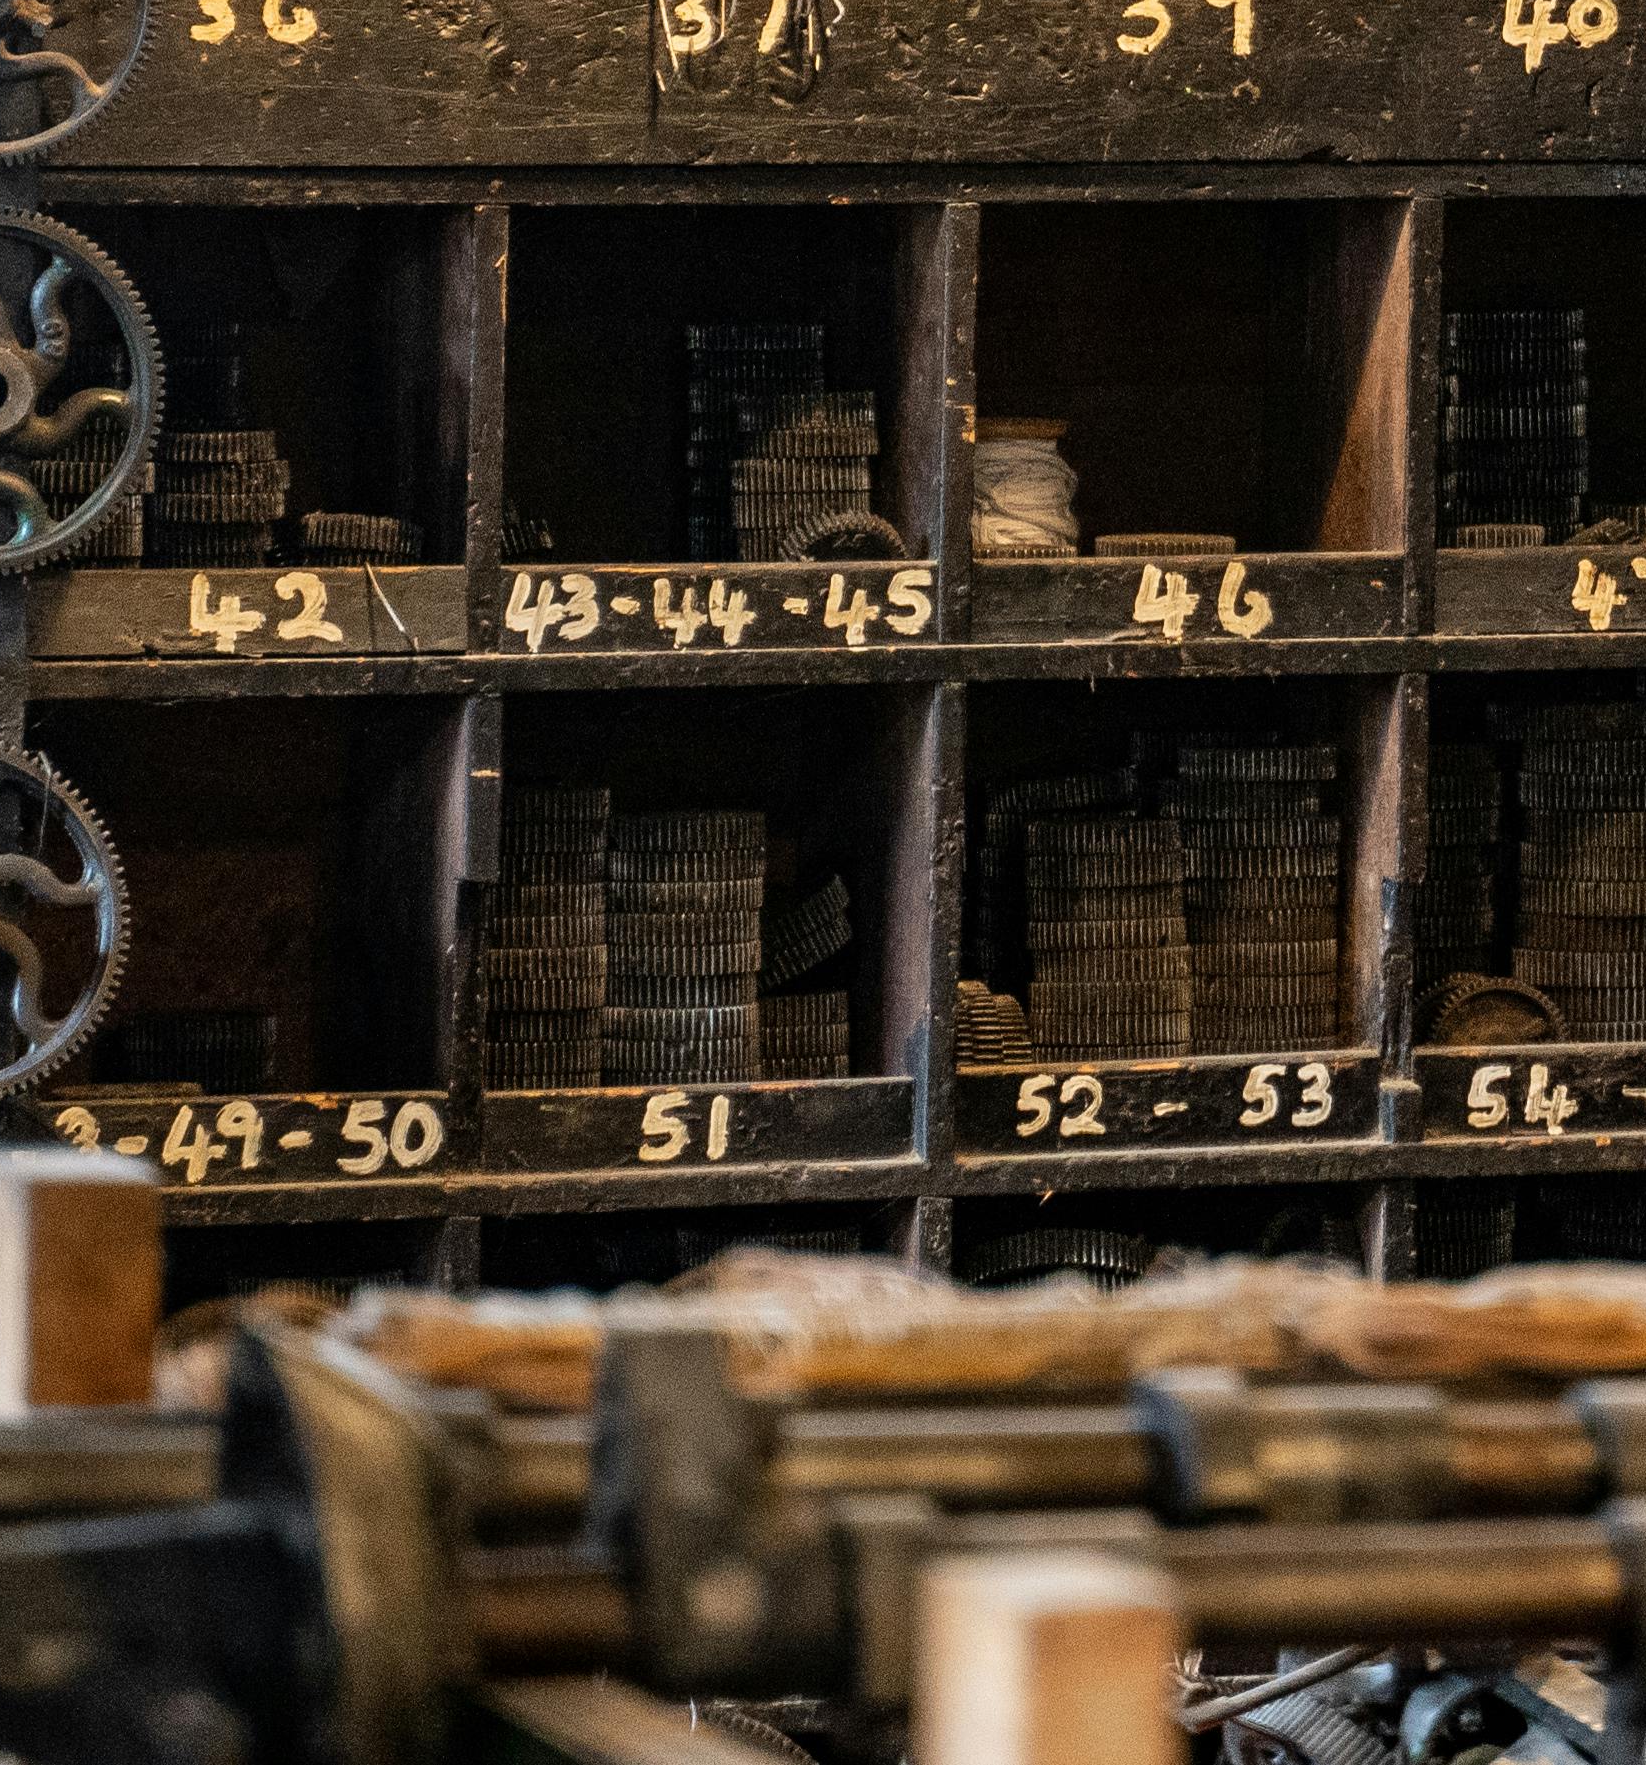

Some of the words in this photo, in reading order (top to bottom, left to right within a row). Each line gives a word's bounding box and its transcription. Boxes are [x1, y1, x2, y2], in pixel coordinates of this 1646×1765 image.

[189, 572, 343, 653] 42
[1133, 563, 1272, 644] 46
[639, 1091, 729, 1161] 51
[1017, 1074, 1106, 1136] 52
[1240, 1063, 1332, 1127] 53
[1468, 1065, 1578, 1135] 54
